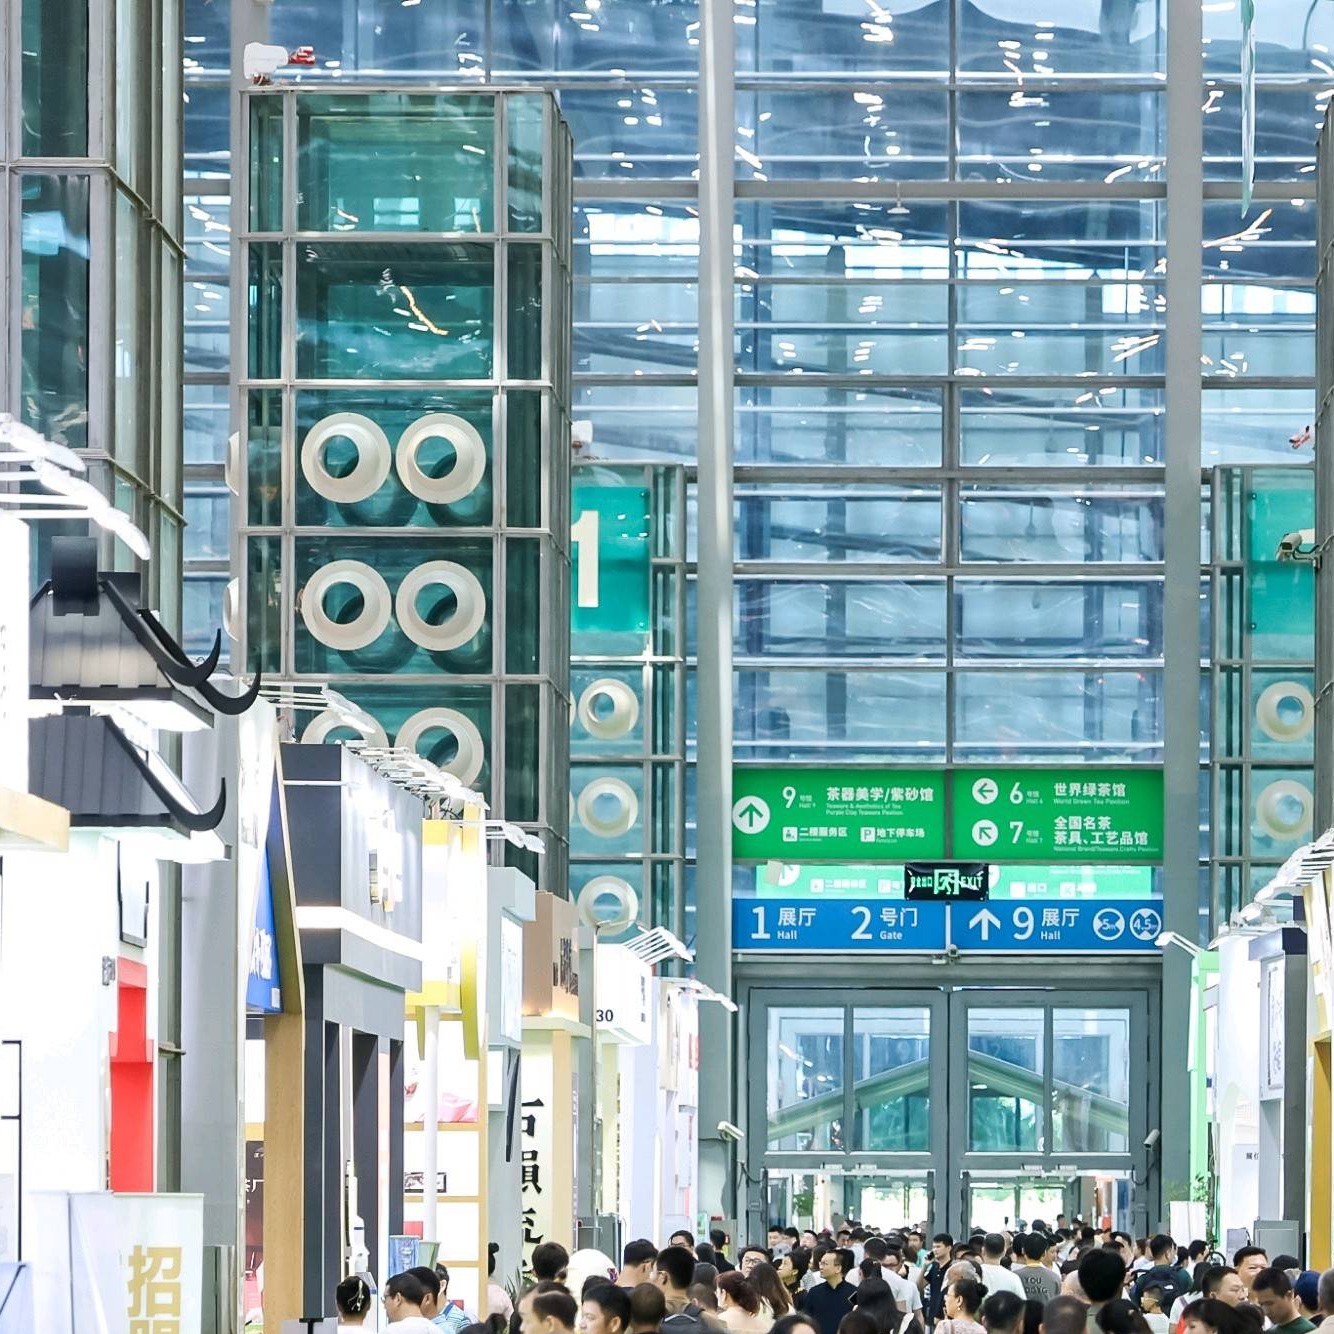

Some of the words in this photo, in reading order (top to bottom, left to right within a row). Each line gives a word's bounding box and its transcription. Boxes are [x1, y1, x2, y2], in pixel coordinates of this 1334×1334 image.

[571, 510, 599, 608] 1
[782, 786, 796, 808] 9
[826, 786, 934, 802] 茶器美学/紫砂馆
[1009, 782, 1023, 804] 6
[1053, 782, 1127, 798] 世界绿茶馆
[1053, 816, 1112, 830] 全国名茶
[799, 827, 848, 837] 二楼服务区
[876, 828, 925, 838] 地下停车场
[1009, 821, 1023, 844] 7
[1053, 831, 1148, 845] 茶具、工艺品馆
[960, 875, 984, 888] EXIT
[751, 906, 770, 939] 1
[778, 907, 816, 926] 展厅
[851, 906, 873, 939] 2
[880, 907, 918, 927] 号门
[1012, 906, 1034, 940] 9
[1041, 908, 1080, 927] 展厅
[777, 930, 797, 939] Hall
[879, 930, 903, 940] Gate
[1041, 931, 1061, 940] Hall
